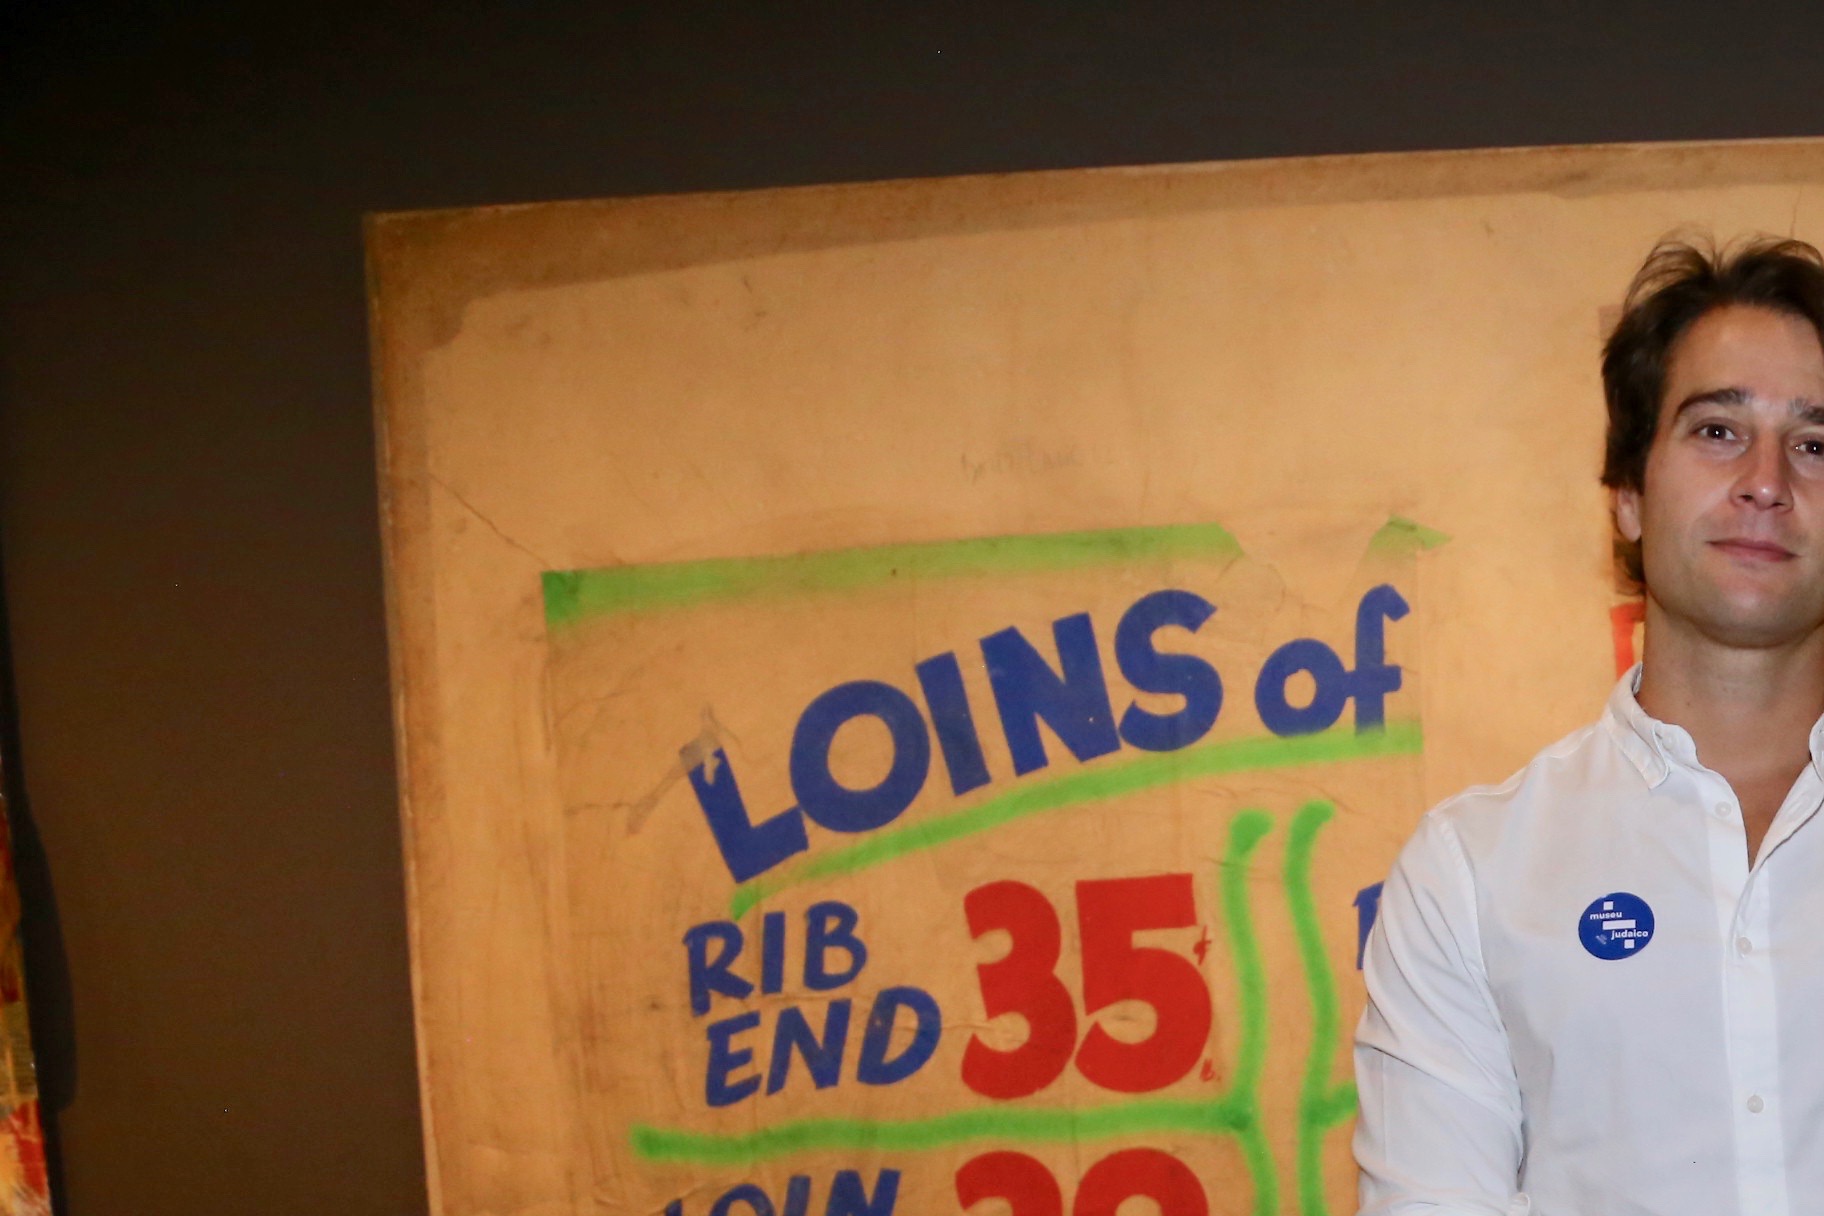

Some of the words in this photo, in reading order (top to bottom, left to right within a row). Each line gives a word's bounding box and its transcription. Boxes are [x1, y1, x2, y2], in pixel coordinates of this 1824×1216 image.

[680, 589, 1224, 883] LOINS
[1254, 583, 1411, 737] of
[682, 900, 868, 1018] RIB
[1589, 911, 1623, 920] museu
[1611, 929, 1649, 940] judaico
[703, 985, 942, 1108] END
